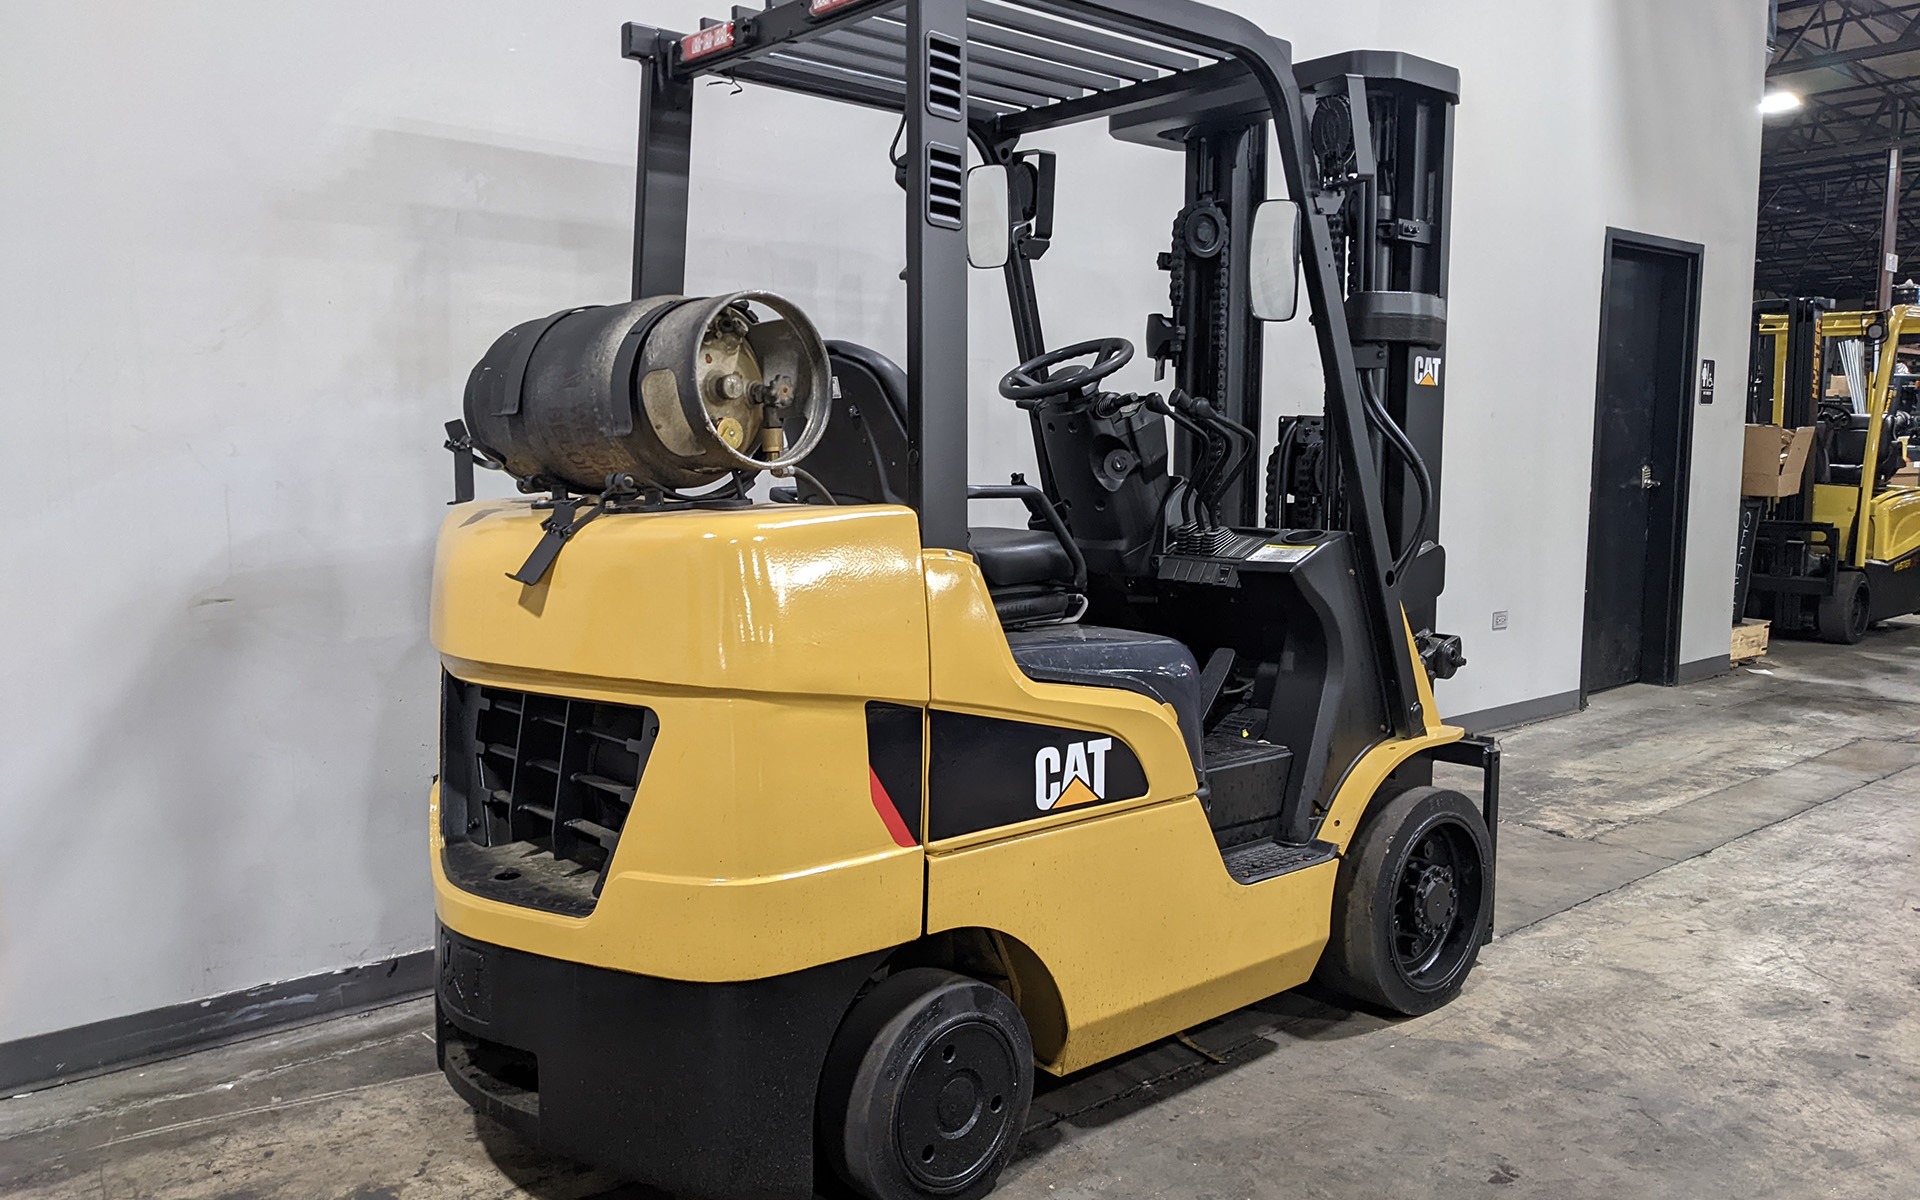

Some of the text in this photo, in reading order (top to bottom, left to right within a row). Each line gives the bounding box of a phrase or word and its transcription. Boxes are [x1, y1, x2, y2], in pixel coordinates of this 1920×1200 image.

[1414, 355, 1441, 386] CAT
[1812, 318, 1822, 399] HYSTER
[1035, 737, 1112, 811] CAT
